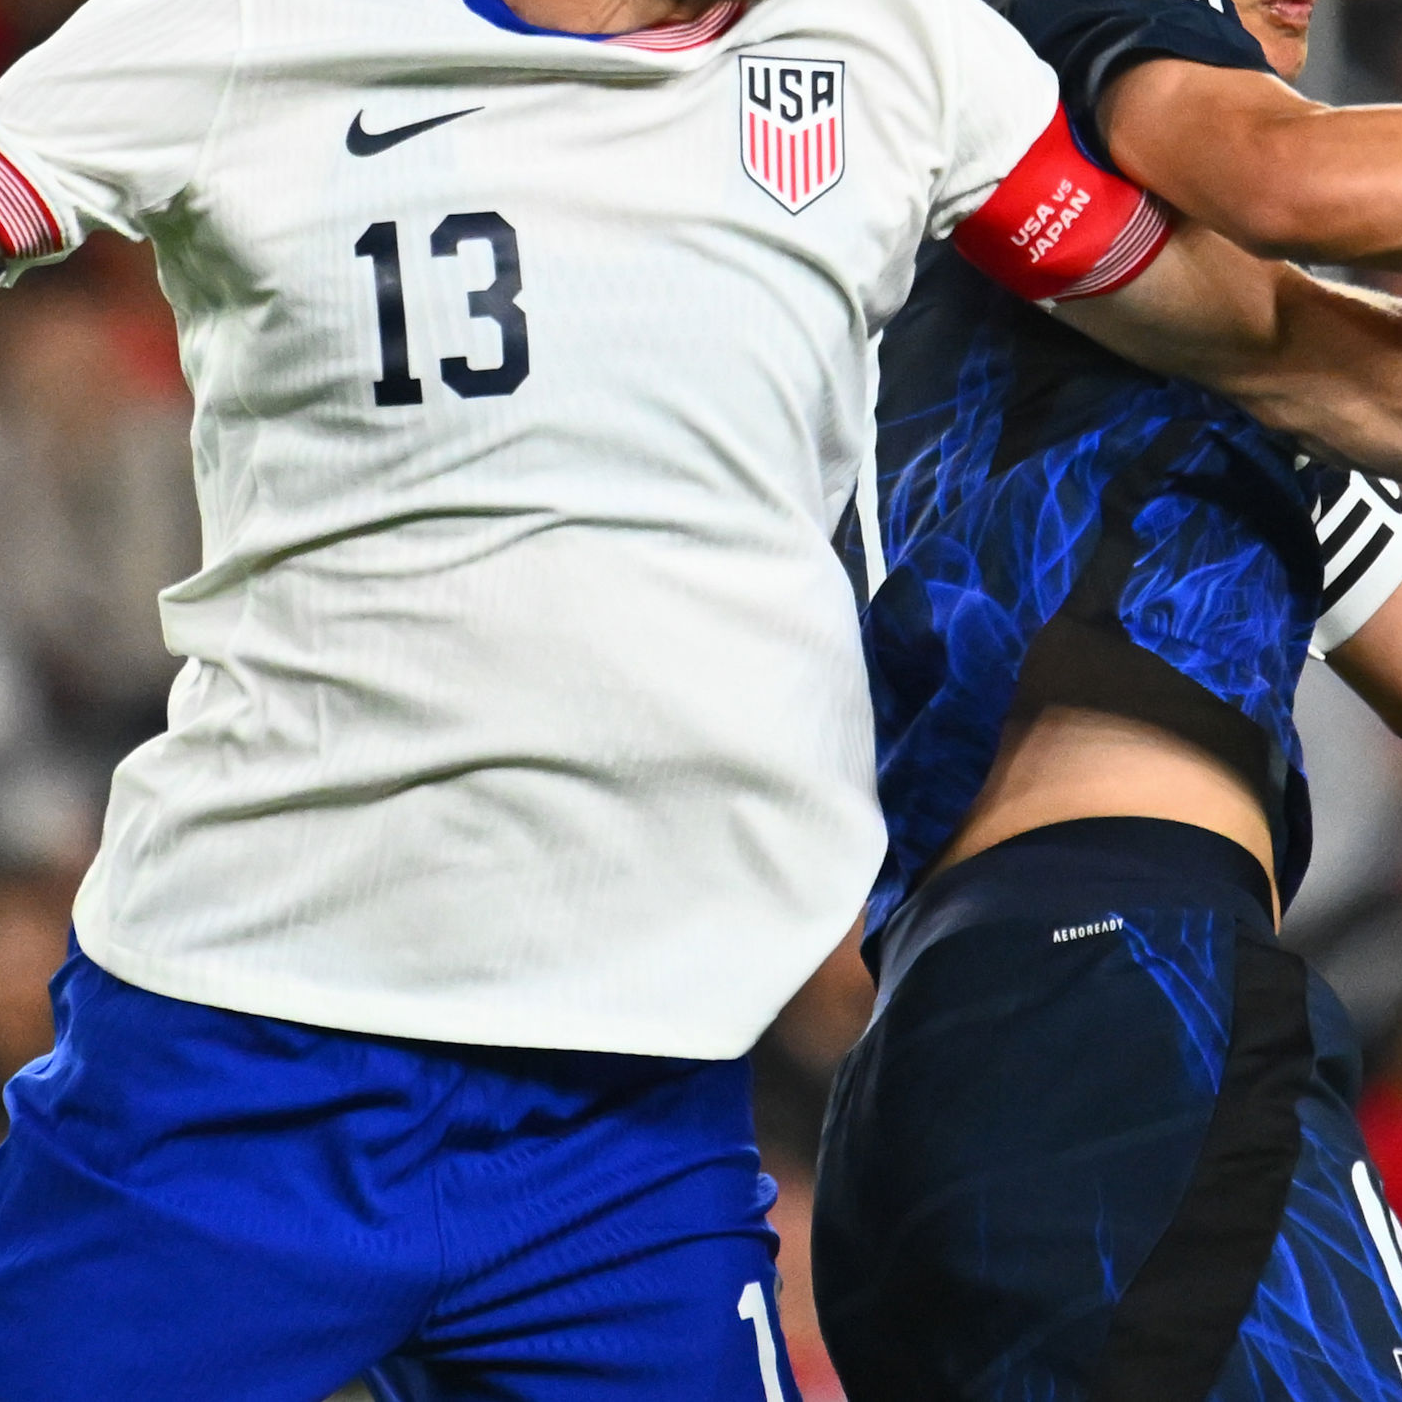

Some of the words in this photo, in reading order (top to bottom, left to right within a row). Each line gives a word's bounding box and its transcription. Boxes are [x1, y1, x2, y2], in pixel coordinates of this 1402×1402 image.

[747, 65, 835, 124] USA
[1010, 204, 1056, 247] USA
[1028, 187, 1091, 264] JAPAN
[354, 210, 531, 407] 13
[1053, 917, 1124, 944] AEROREADY
